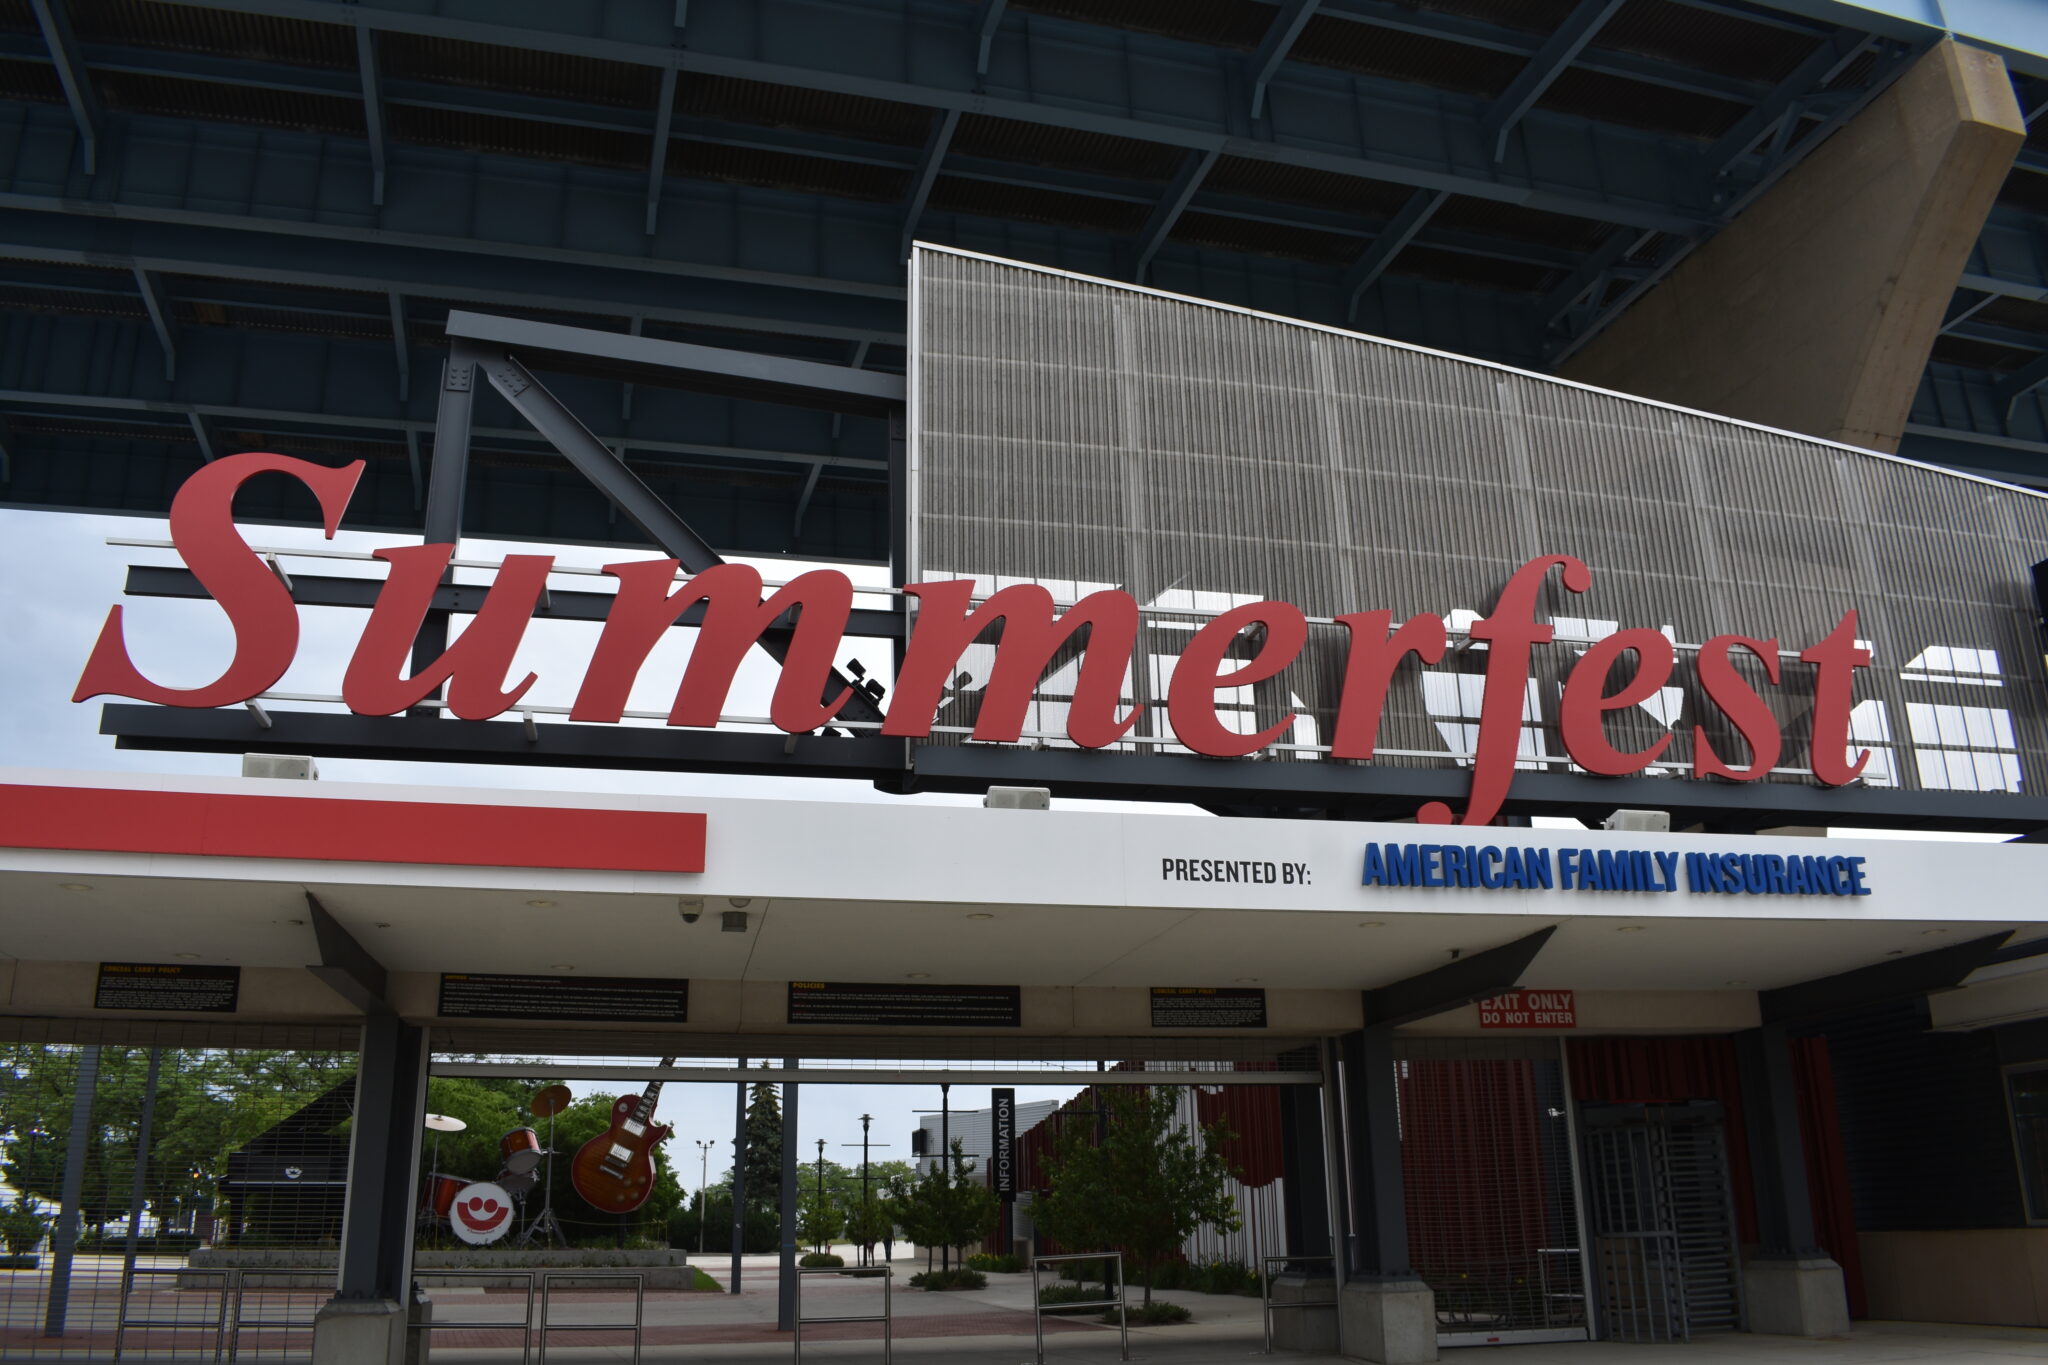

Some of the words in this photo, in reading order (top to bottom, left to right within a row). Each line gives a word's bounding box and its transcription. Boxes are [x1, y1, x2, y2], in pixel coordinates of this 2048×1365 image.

[72, 452, 1871, 826] Summerfest
[1162, 858, 1277, 884] PRESENTED
[1282, 862, 1311, 885] BY:
[1362, 842, 1554, 889] AMERICAN
[1557, 848, 1680, 892] FAMILY
[1684, 852, 1871, 896] INSURANCE
[1481, 993, 1520, 1010] EXIT
[1527, 993, 1571, 1010] ONLY
[1482, 1012, 1500, 1024] DO
[1505, 1012, 1530, 1024] NOT
[1534, 1012, 1573, 1024] ENTER
[998, 1098, 1010, 1191] INFORMATION
